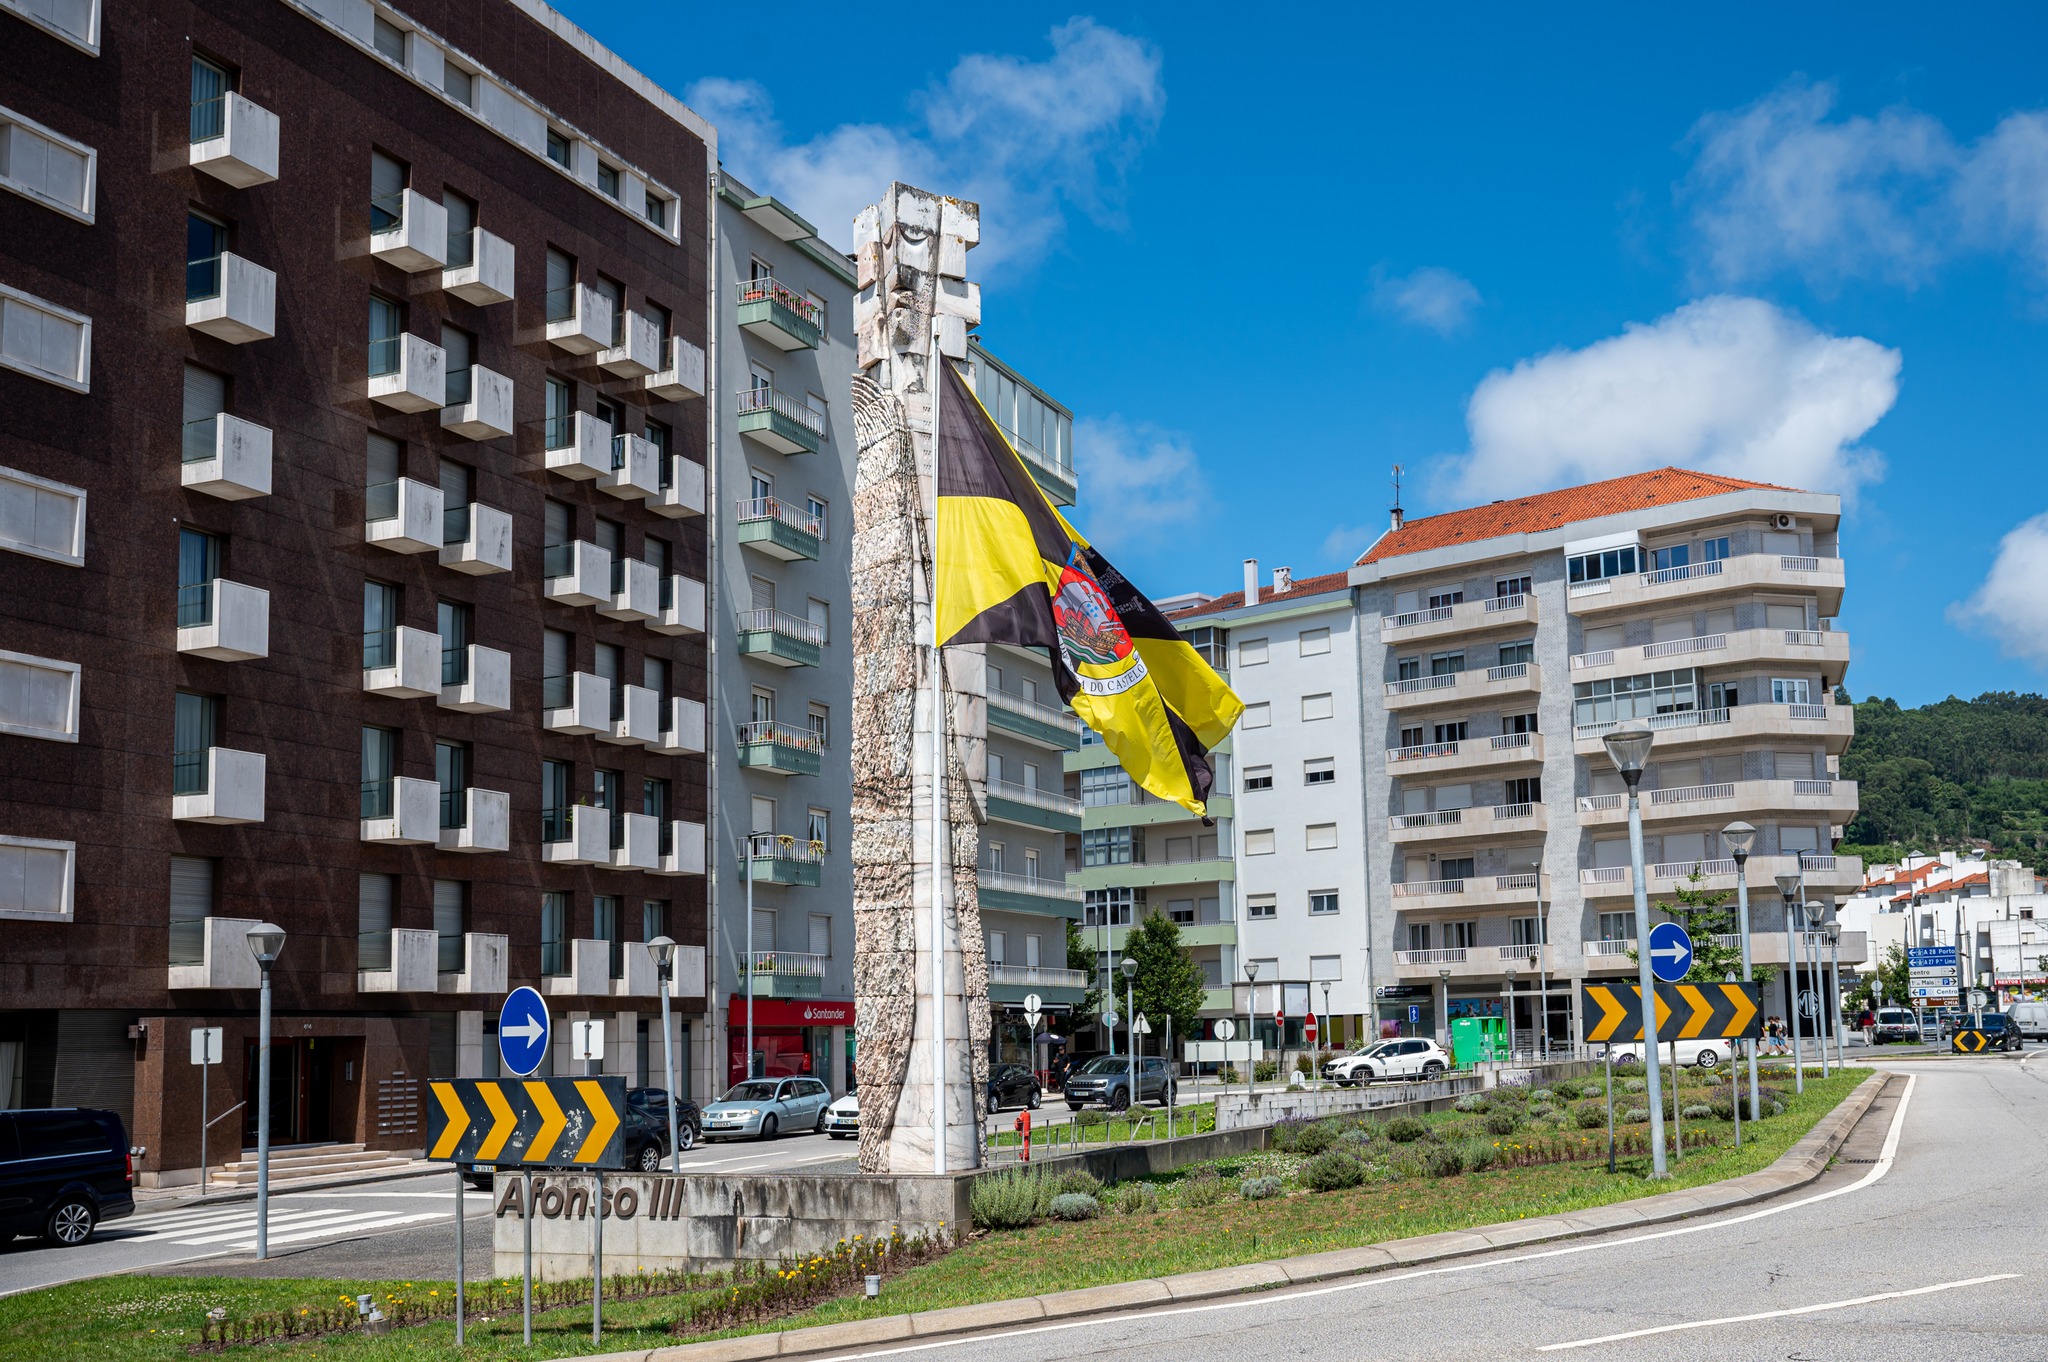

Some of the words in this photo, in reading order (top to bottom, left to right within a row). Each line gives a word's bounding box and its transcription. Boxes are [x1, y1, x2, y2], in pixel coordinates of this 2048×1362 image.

[1090, 682, 1104, 692] DO
[1107, 664, 1144, 692] CASTELO
[813, 1008, 846, 1019] Santander
[1798, 992, 1819, 1016] MG
[496, 1177, 638, 1218] Afonso
[649, 1178, 686, 1218] III
